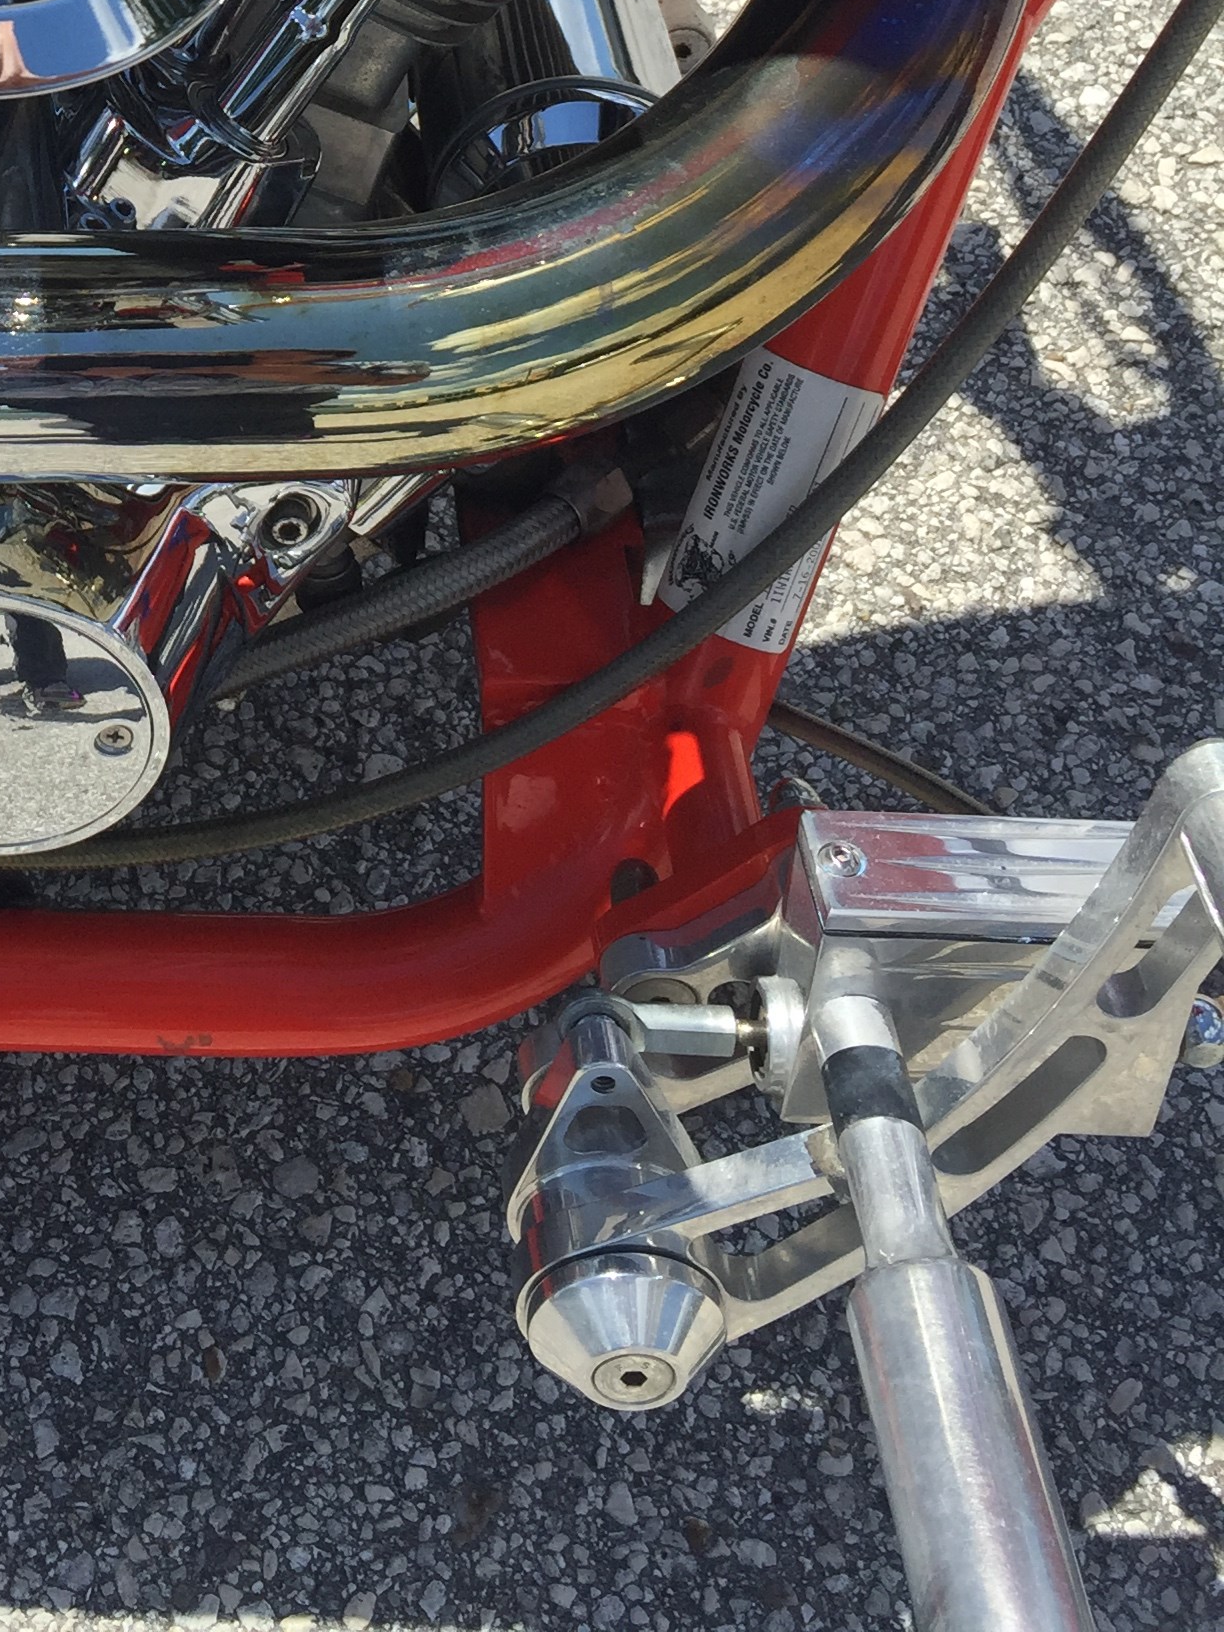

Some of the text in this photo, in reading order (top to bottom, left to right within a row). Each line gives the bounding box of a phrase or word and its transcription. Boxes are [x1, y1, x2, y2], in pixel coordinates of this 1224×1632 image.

[700, 357, 774, 521] IRONWORKS Motorcycle Co.
[742, 600, 764, 638] MODEL
[777, 618, 793, 646] DATE
